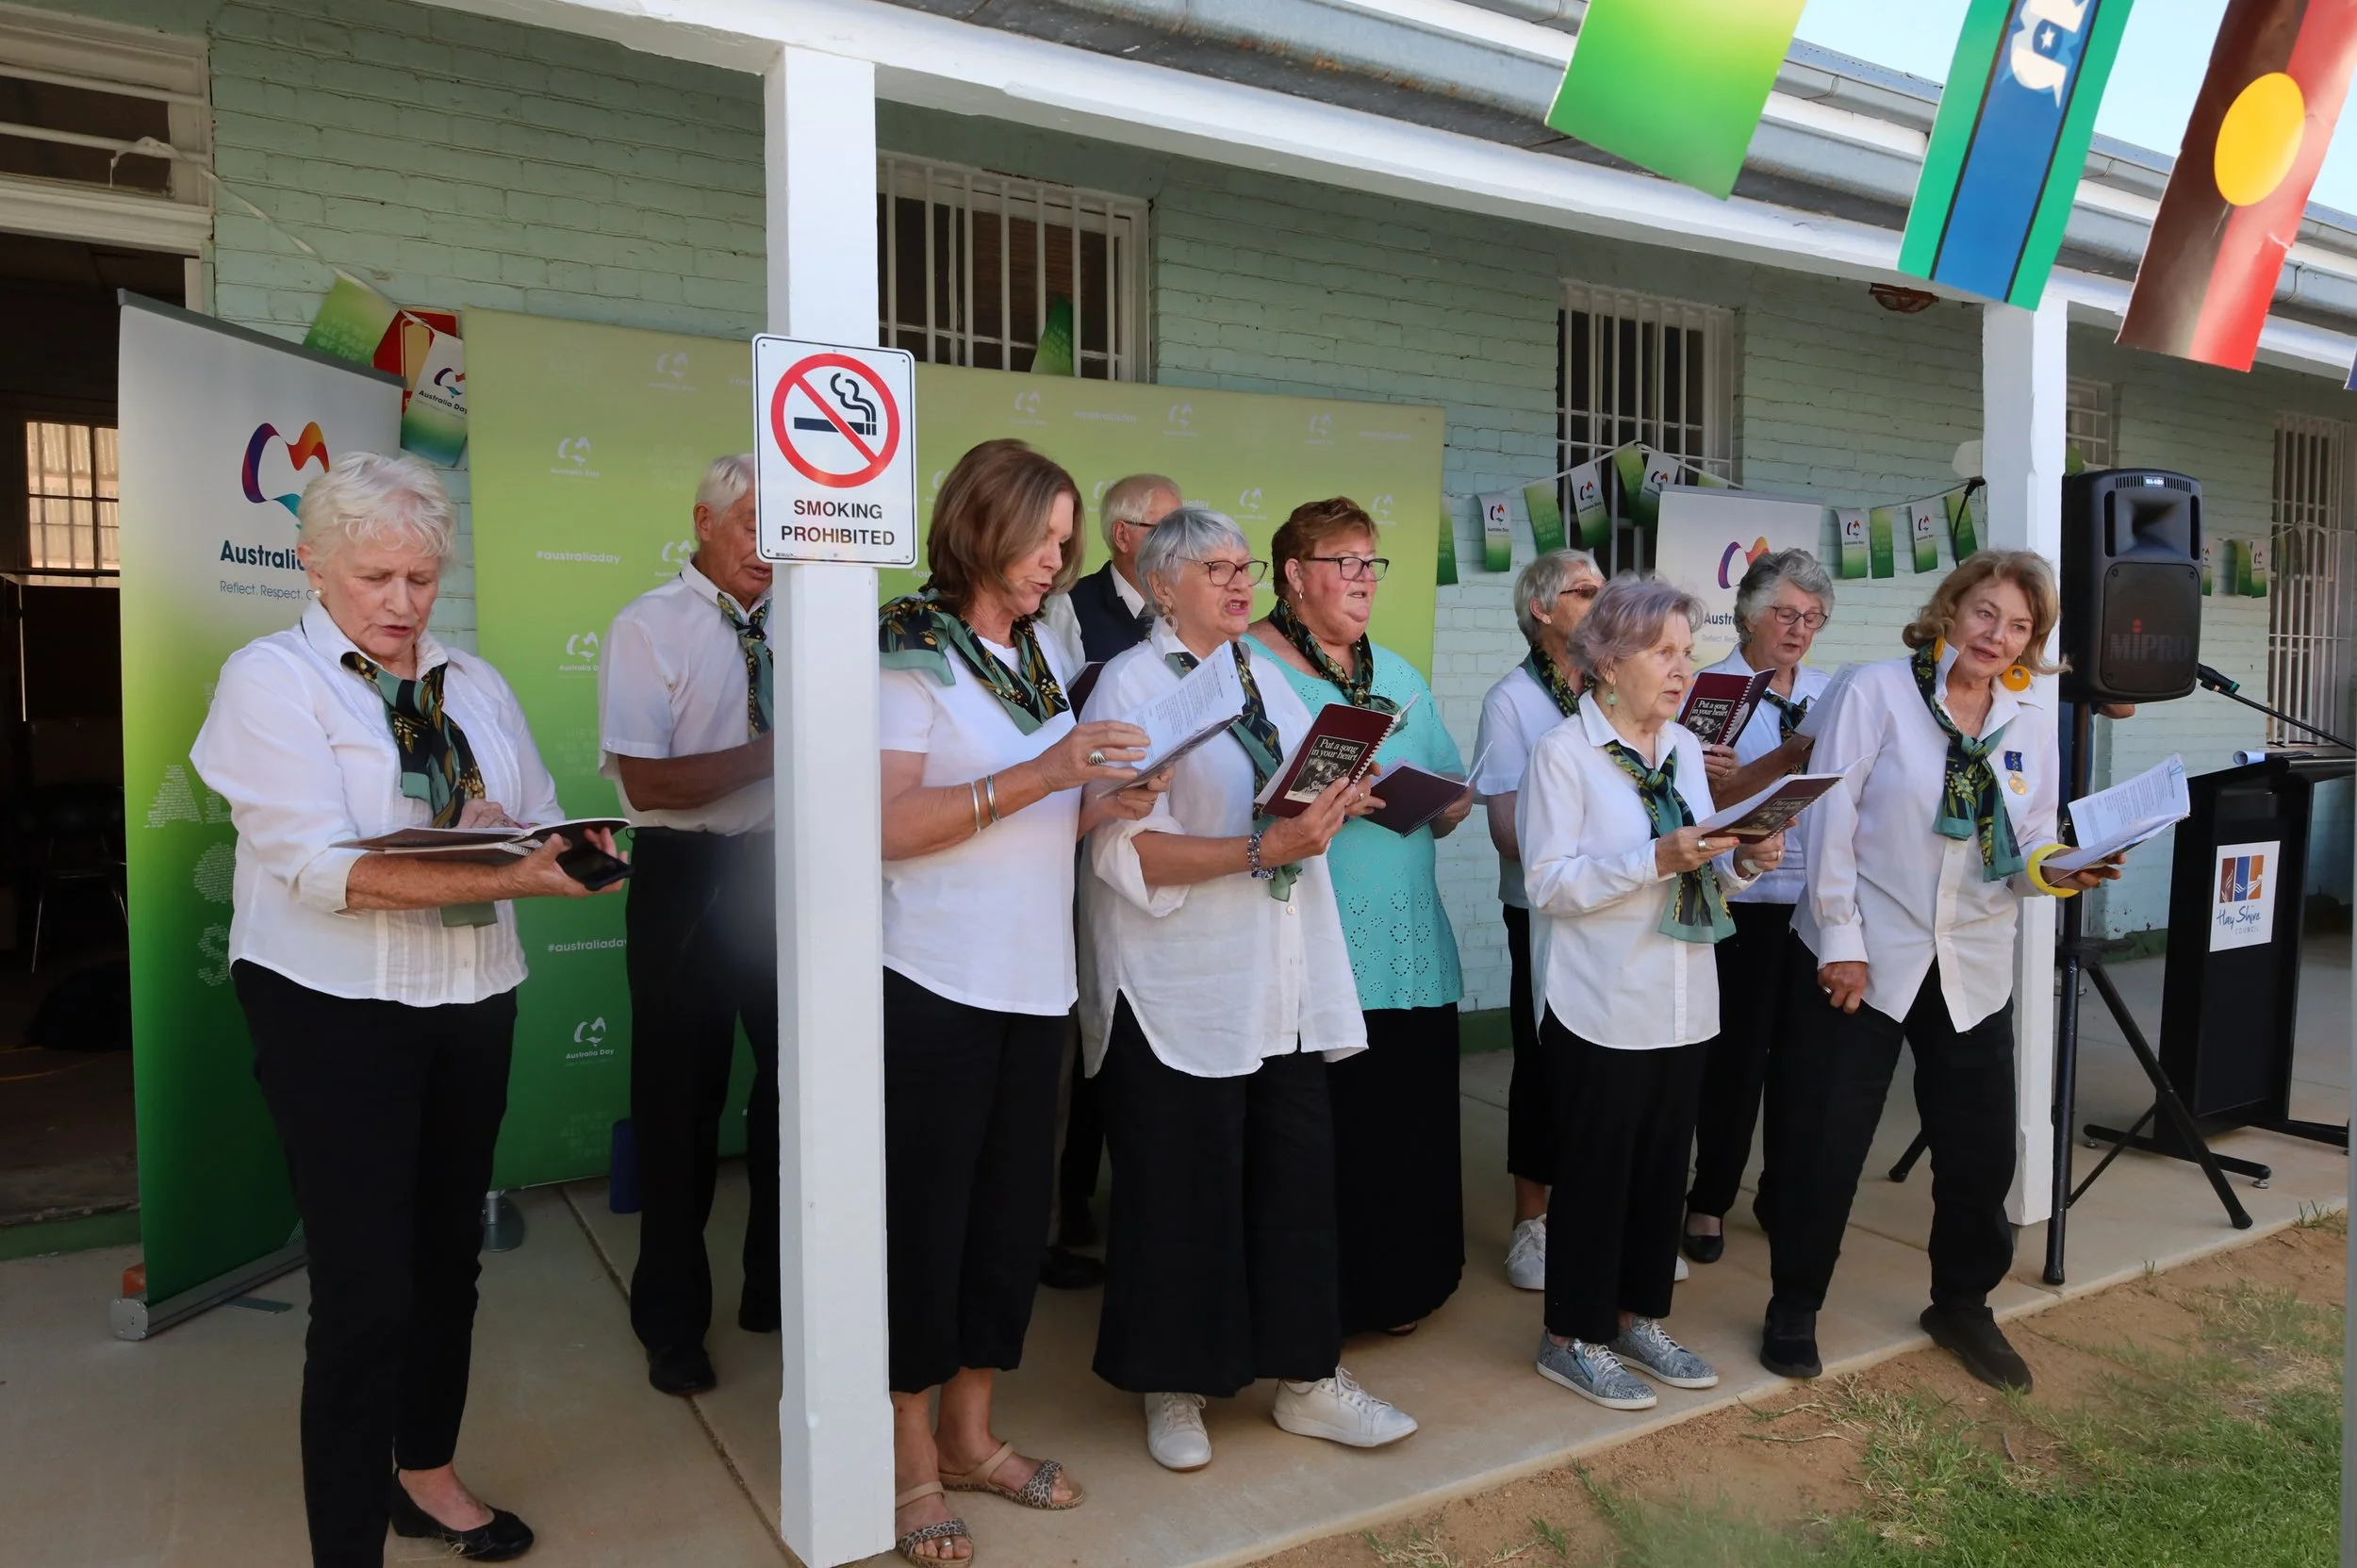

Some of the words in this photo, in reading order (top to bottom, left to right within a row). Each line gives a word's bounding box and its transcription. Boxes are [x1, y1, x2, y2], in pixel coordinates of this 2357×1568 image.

[418, 389, 453, 407] Australia
[453, 403, 468, 415] Day
[794, 499, 882, 520] SMOKING
[781, 525, 896, 546] PROHIBITED
[536, 550, 620, 565] #australiaday
[220, 580, 258, 596] Reflect.
[260, 584, 303, 601] Respect.
[1699, 700, 1710, 709] Put
[1311, 746, 1319, 754] in
[1318, 750, 1337, 758] your
[1337, 751, 1358, 761] heart
[1320, 738, 1334, 749] Put
[1341, 743, 1359, 754] song
[2217, 909, 2234, 931] Hay
[2236, 905, 2261, 925] Shire
[2234, 927, 2260, 935] COUNCIL
[566, 1050, 598, 1059] Australia
